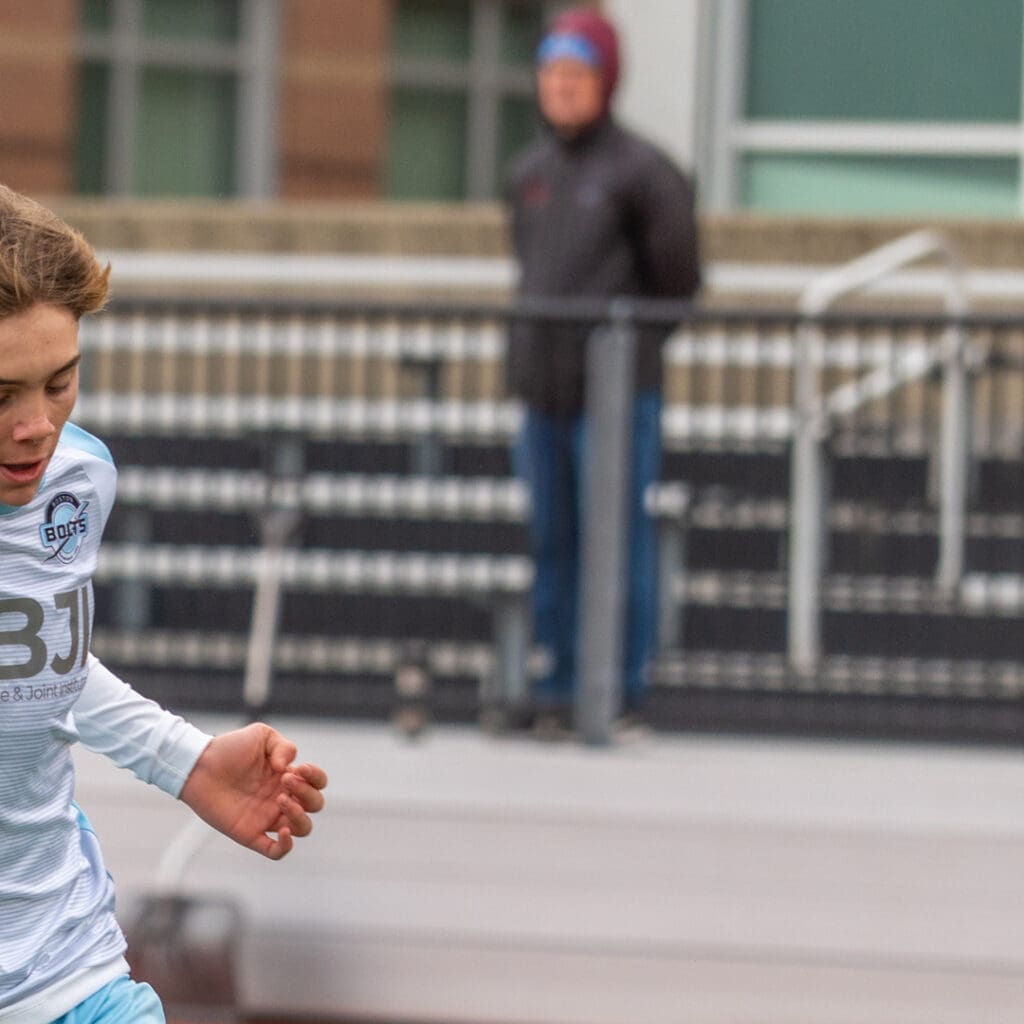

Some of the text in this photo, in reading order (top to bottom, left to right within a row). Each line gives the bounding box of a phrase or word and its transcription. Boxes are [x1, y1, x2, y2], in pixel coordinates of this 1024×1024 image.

[45, 518, 86, 542] BOLTS
[13, 686, 24, 701] &
[26, 684, 58, 700] Joint
